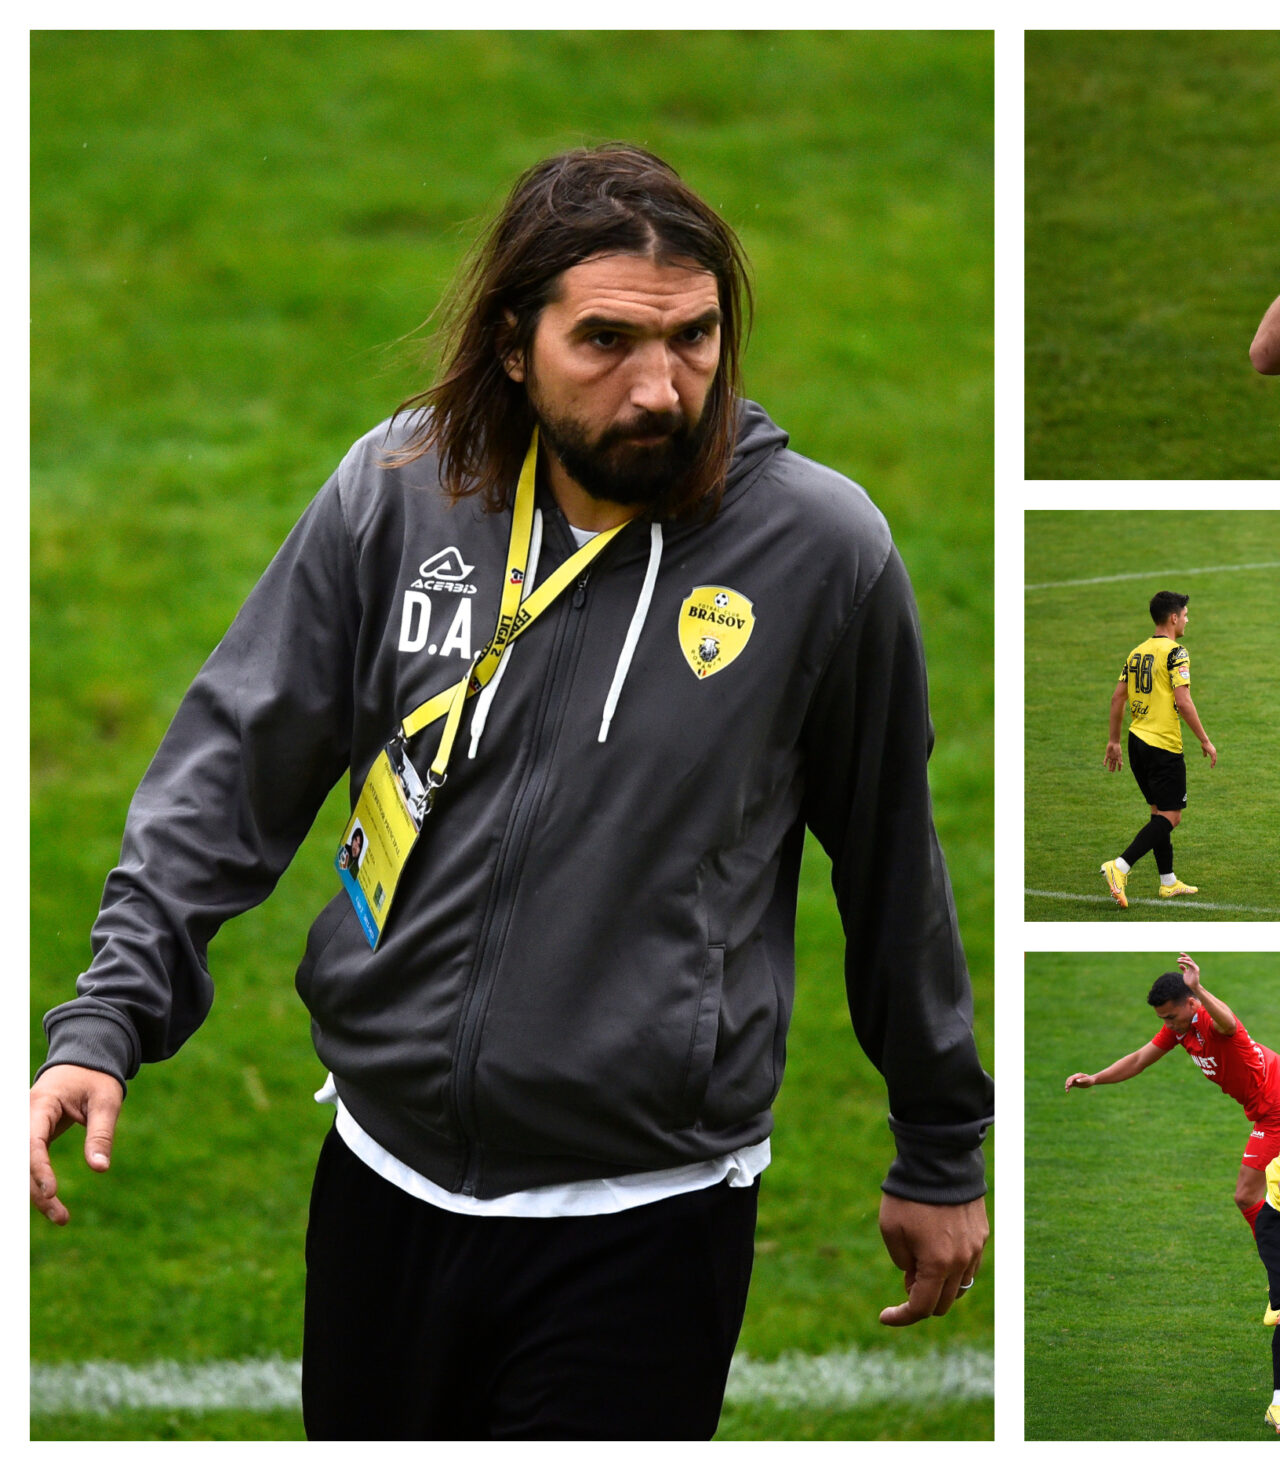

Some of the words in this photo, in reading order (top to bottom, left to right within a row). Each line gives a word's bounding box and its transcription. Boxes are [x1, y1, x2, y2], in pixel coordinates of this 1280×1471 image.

[410, 578, 478, 594] ACERBIS
[495, 614, 514, 645] LIGA
[490, 647, 502, 657] 2
[1129, 653, 1155, 694] 98
